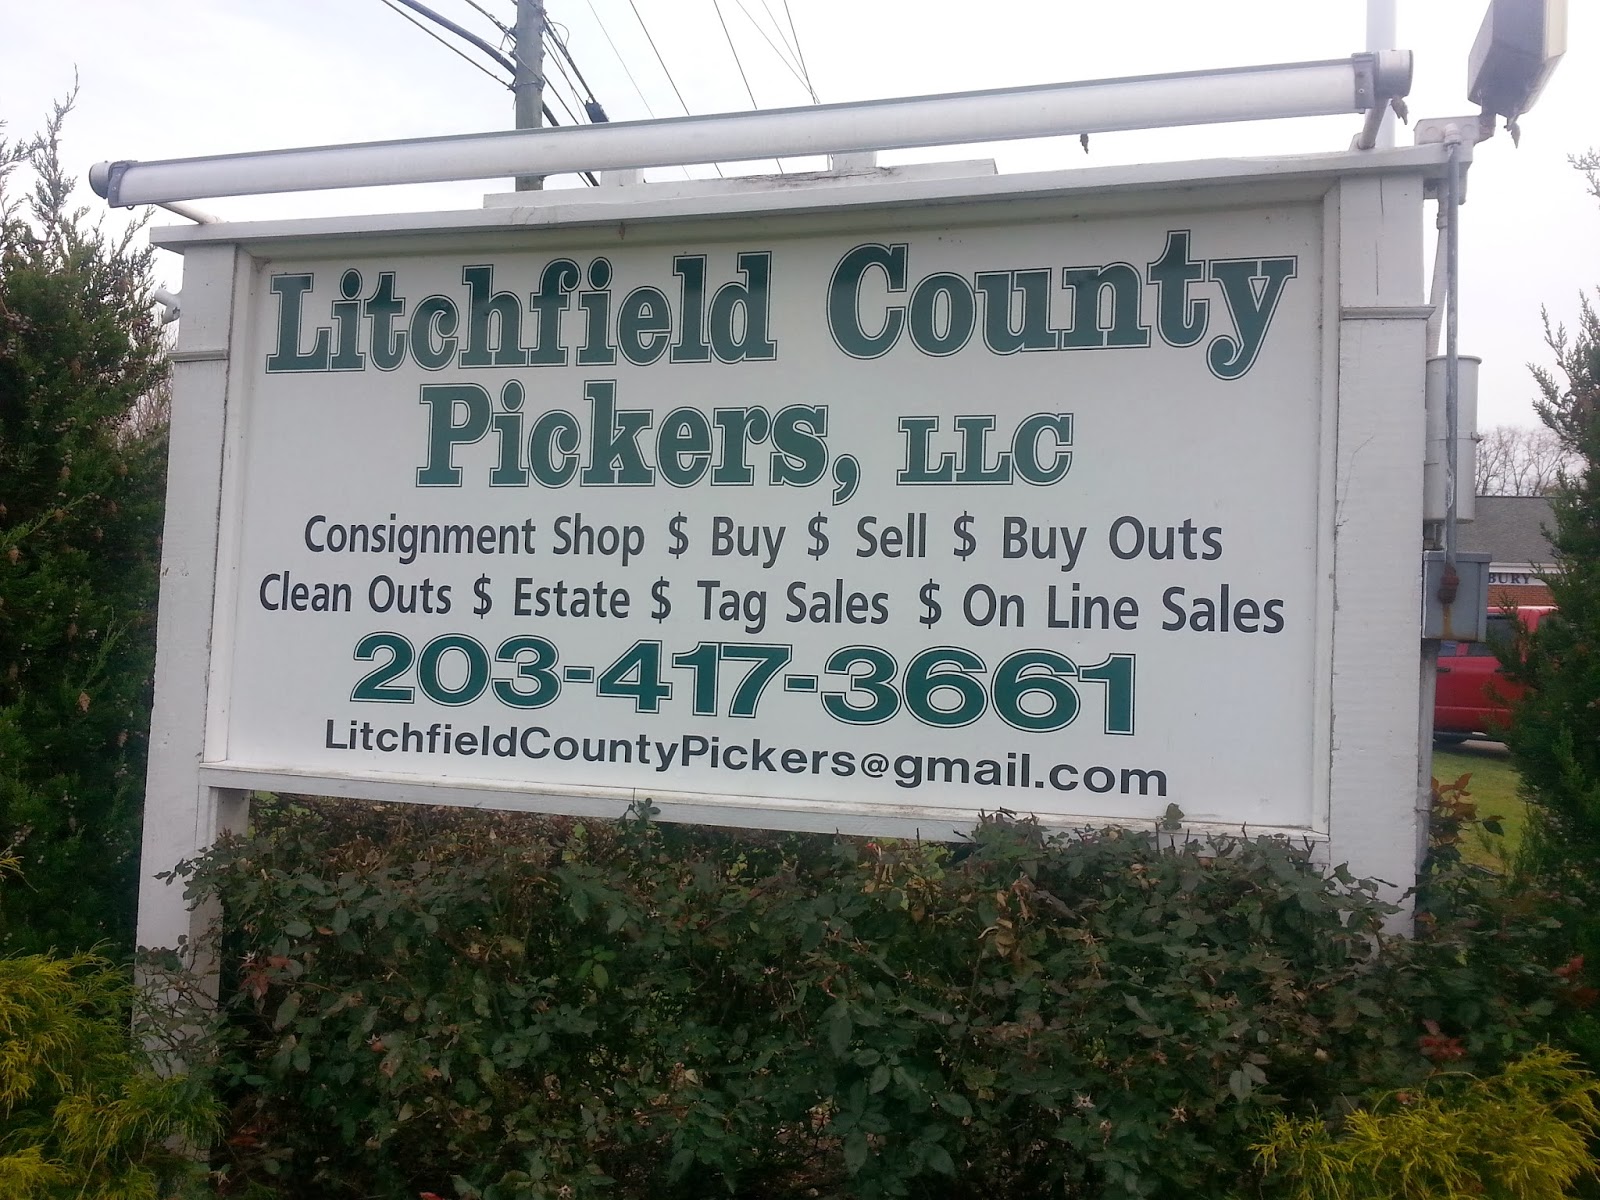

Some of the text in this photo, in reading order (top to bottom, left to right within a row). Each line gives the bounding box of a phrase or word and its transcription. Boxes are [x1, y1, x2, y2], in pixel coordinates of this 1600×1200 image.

[265, 229, 1298, 381] Litchfield County
[415, 379, 1074, 506] Pickers, LLC
[305, 510, 1222, 572] Consignment Shop $ Buy $ Sell $ Buy Outs
[260, 571, 1284, 634] Clean Outs $ Estate $ Tag Sales $ On Line Sales
[349, 631, 1136, 736] 203-417-3661
[326, 719, 1166, 797] LitchfieldCountyPickers@gmail.com
